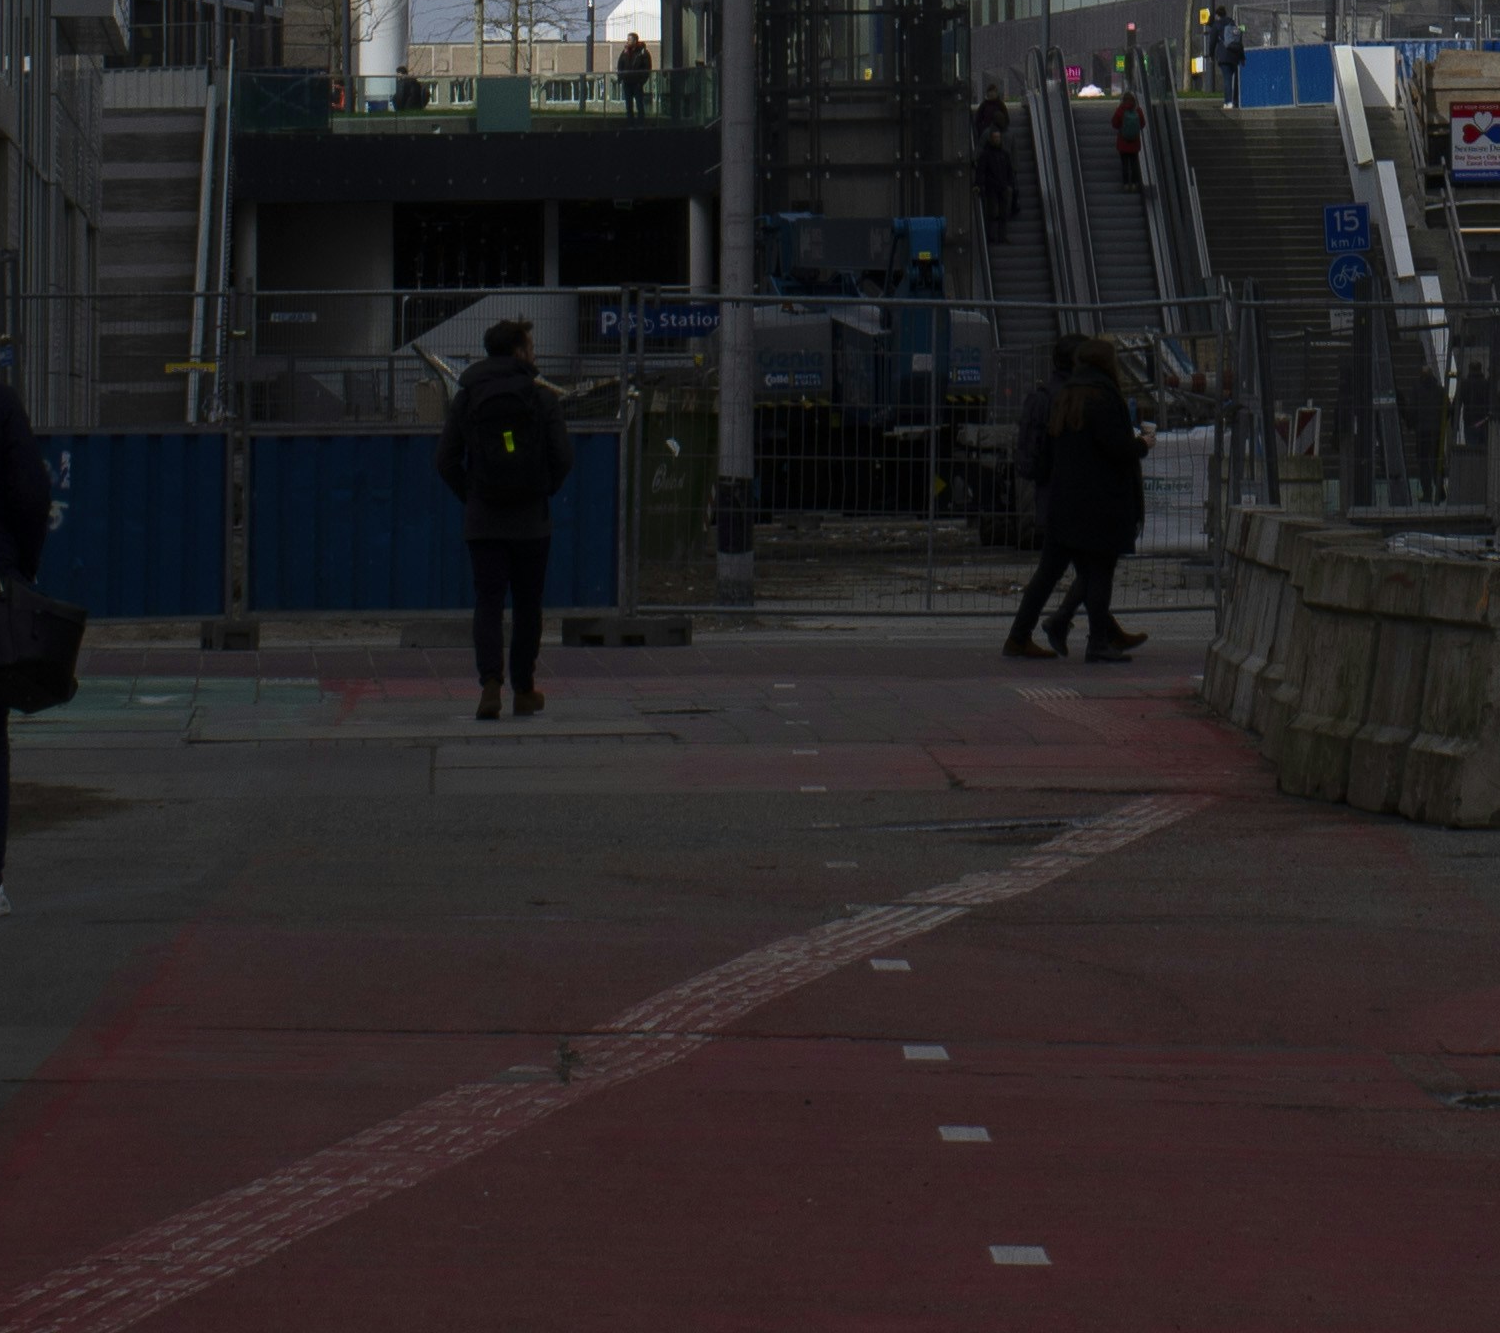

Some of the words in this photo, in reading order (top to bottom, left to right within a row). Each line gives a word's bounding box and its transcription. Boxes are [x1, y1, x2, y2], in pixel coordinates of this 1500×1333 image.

[1333, 209, 1360, 233] 15
[1331, 235, 1365, 249] km/h
[601, 312, 617, 334] P
